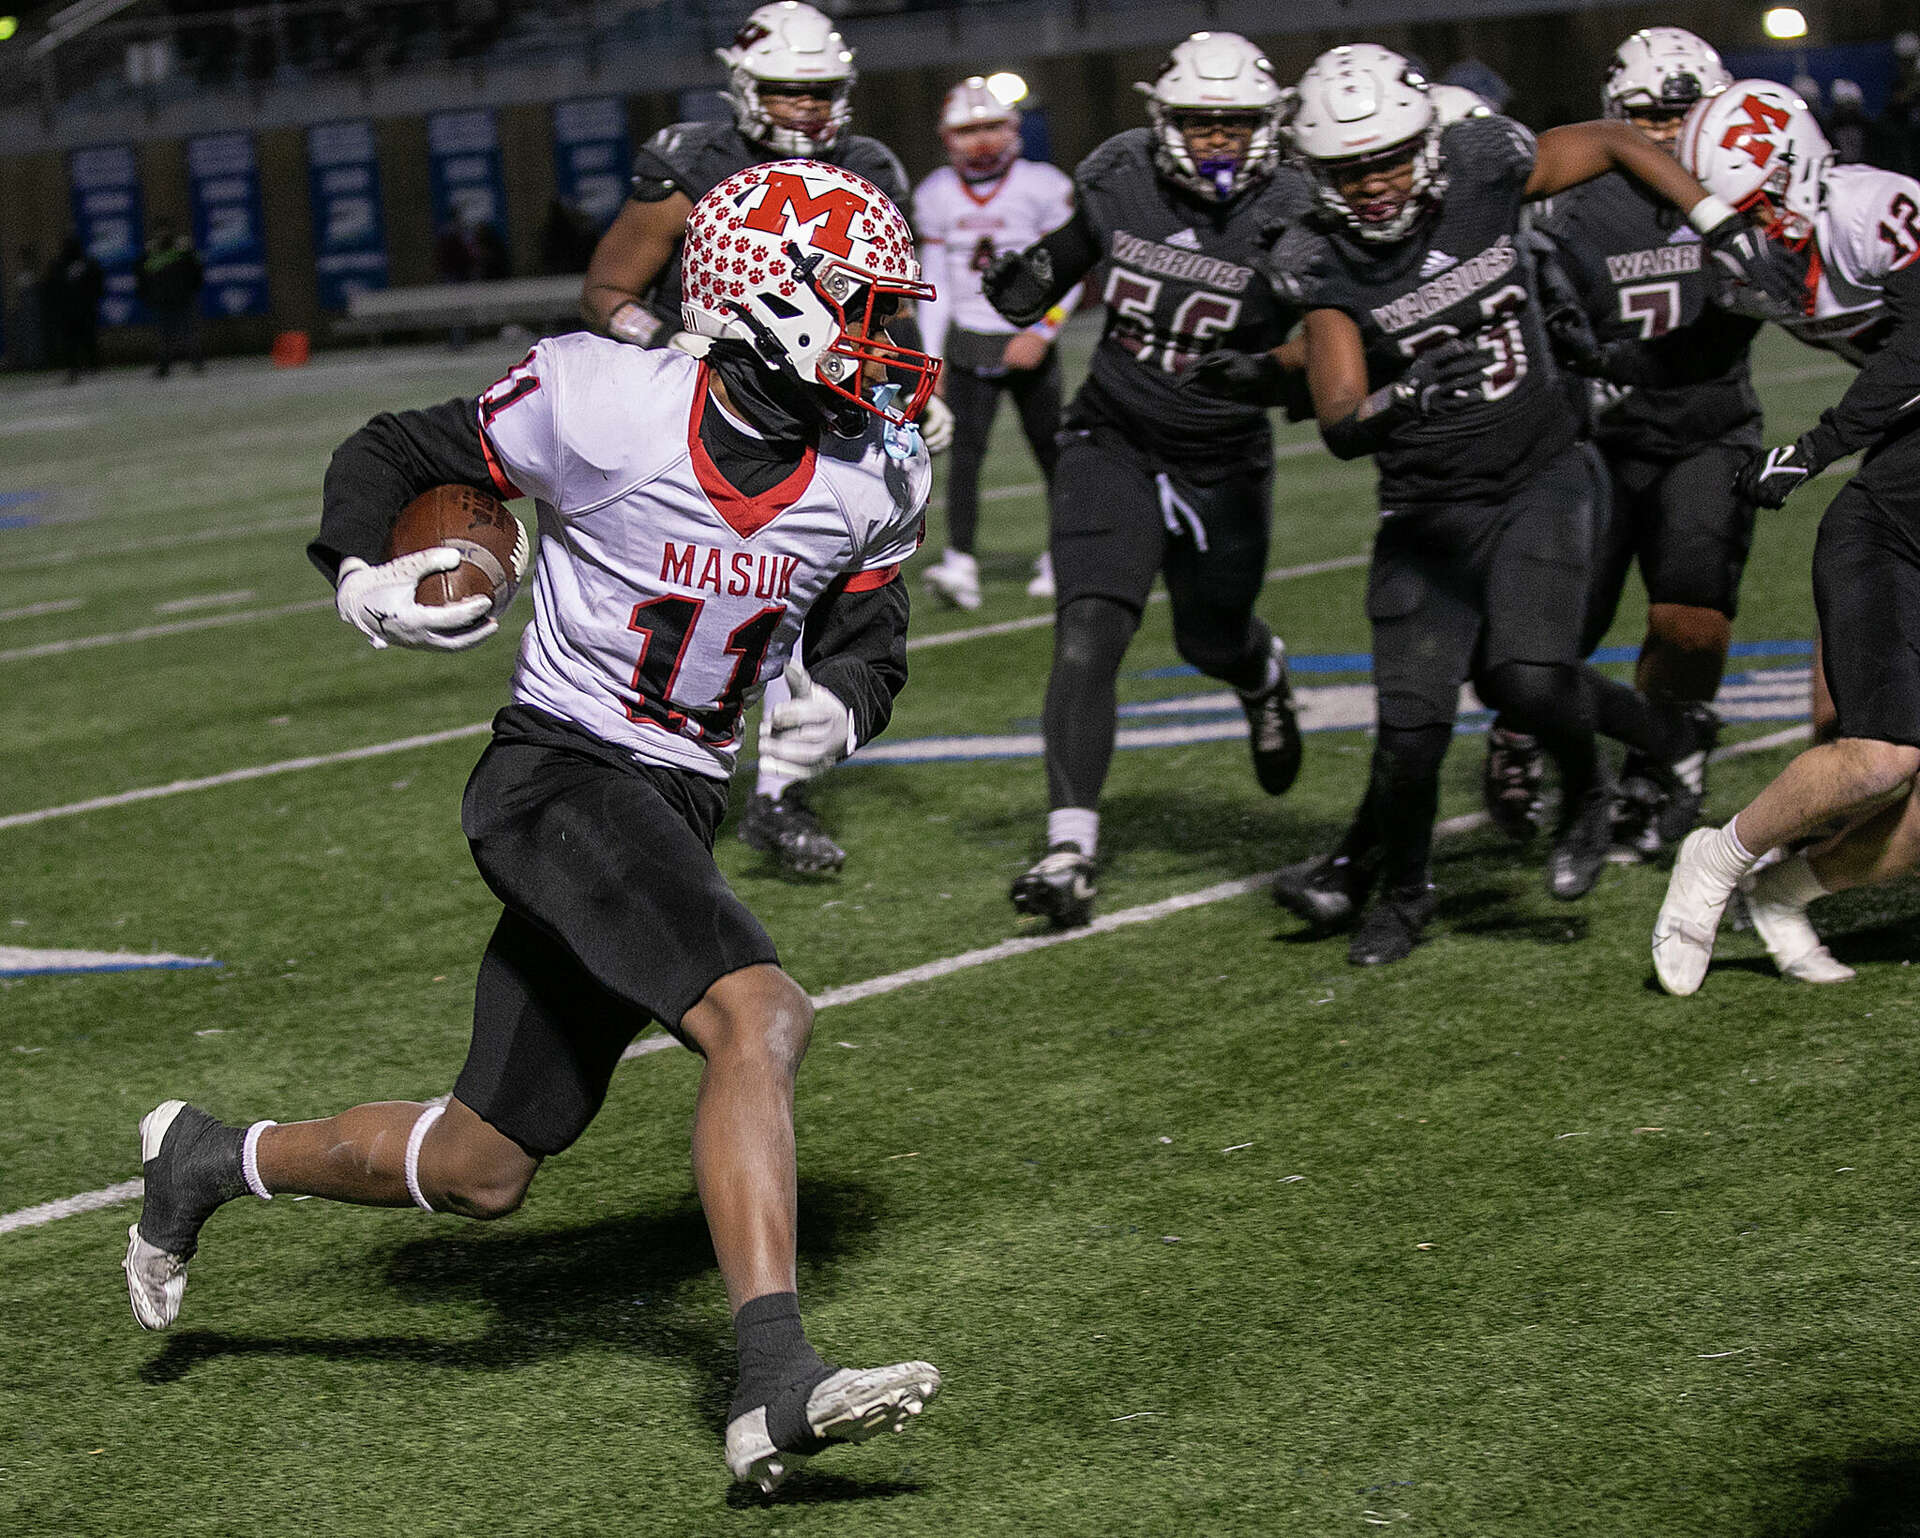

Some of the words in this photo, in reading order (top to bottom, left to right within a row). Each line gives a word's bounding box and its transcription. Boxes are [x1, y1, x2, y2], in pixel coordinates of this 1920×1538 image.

[1720, 94, 1791, 169] M
[743, 170, 869, 260] M
[1111, 229, 1256, 293] WARRIORS
[1606, 243, 1702, 283] WARR
[1619, 280, 1681, 341] 7
[659, 541, 801, 600] MASUK
[627, 592, 788, 747] 11
